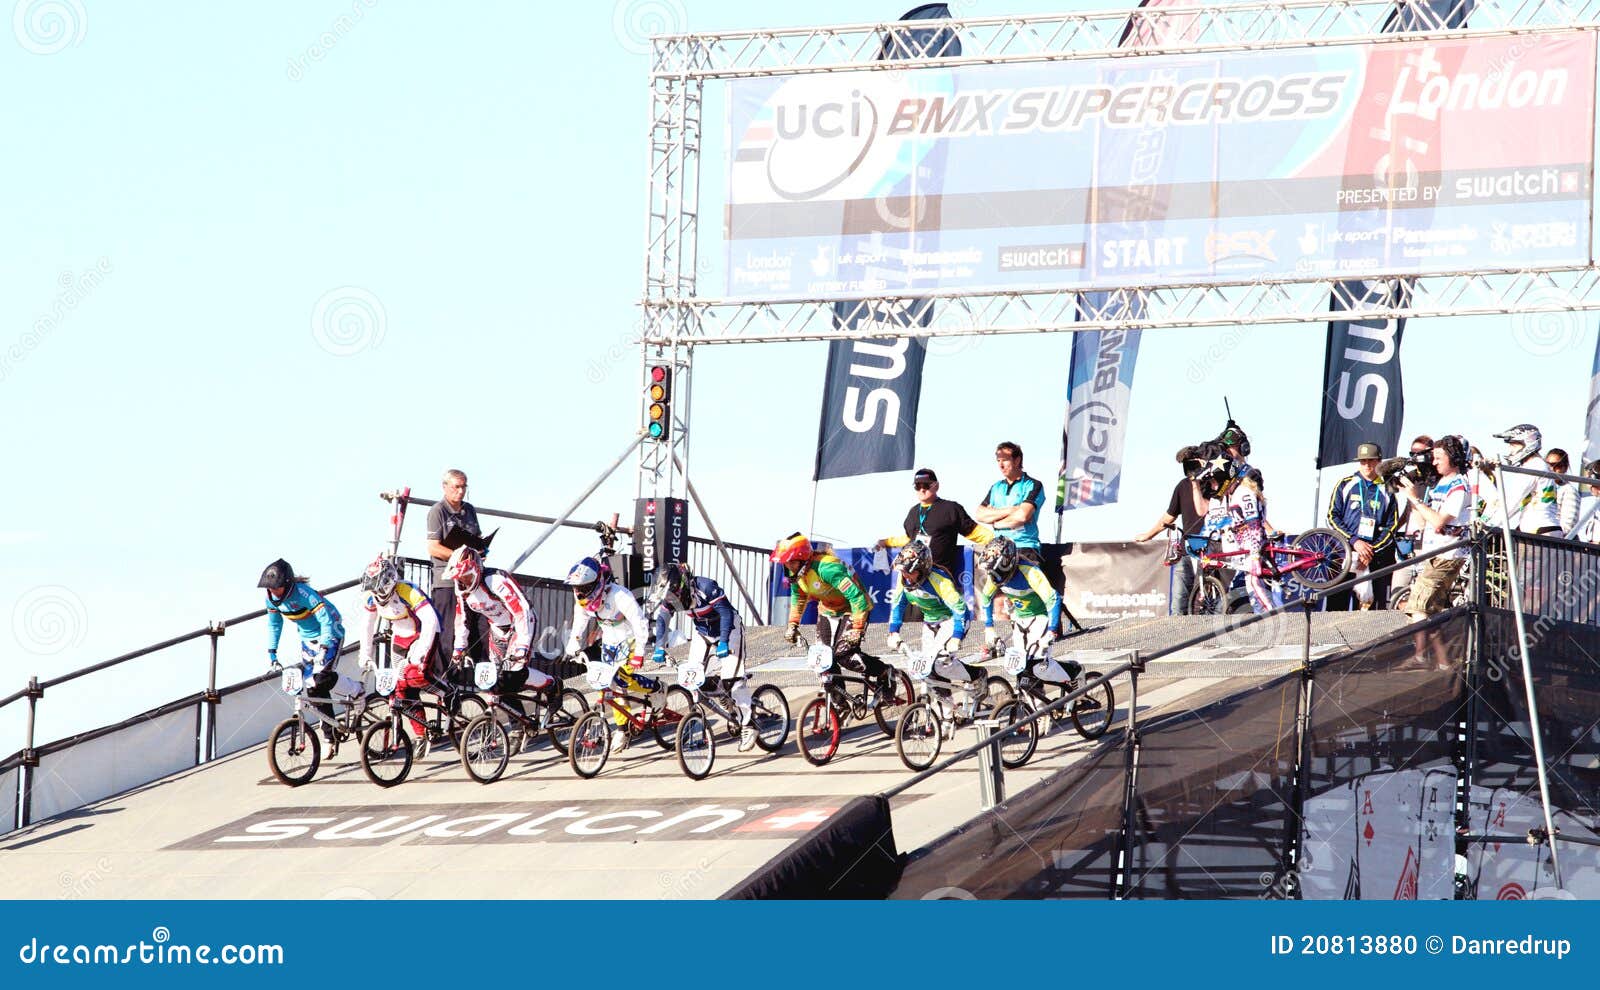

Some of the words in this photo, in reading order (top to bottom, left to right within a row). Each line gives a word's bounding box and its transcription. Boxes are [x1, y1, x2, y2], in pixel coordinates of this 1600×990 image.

[1390, 60, 1570, 115] London
[886, 92, 1003, 136] BMX
[1003, 74, 1347, 131] SUPERCROSS
[1336, 186, 1418, 205] PRESENTED
[1423, 186, 1442, 201] BY
[1455, 169, 1559, 199] swatch
[1001, 247, 1070, 268] swatch
[1103, 238, 1189, 269] START
[642, 514, 656, 586] swatch
[1079, 588, 1167, 609] Panasonic
[211, 804, 748, 844] swatch
